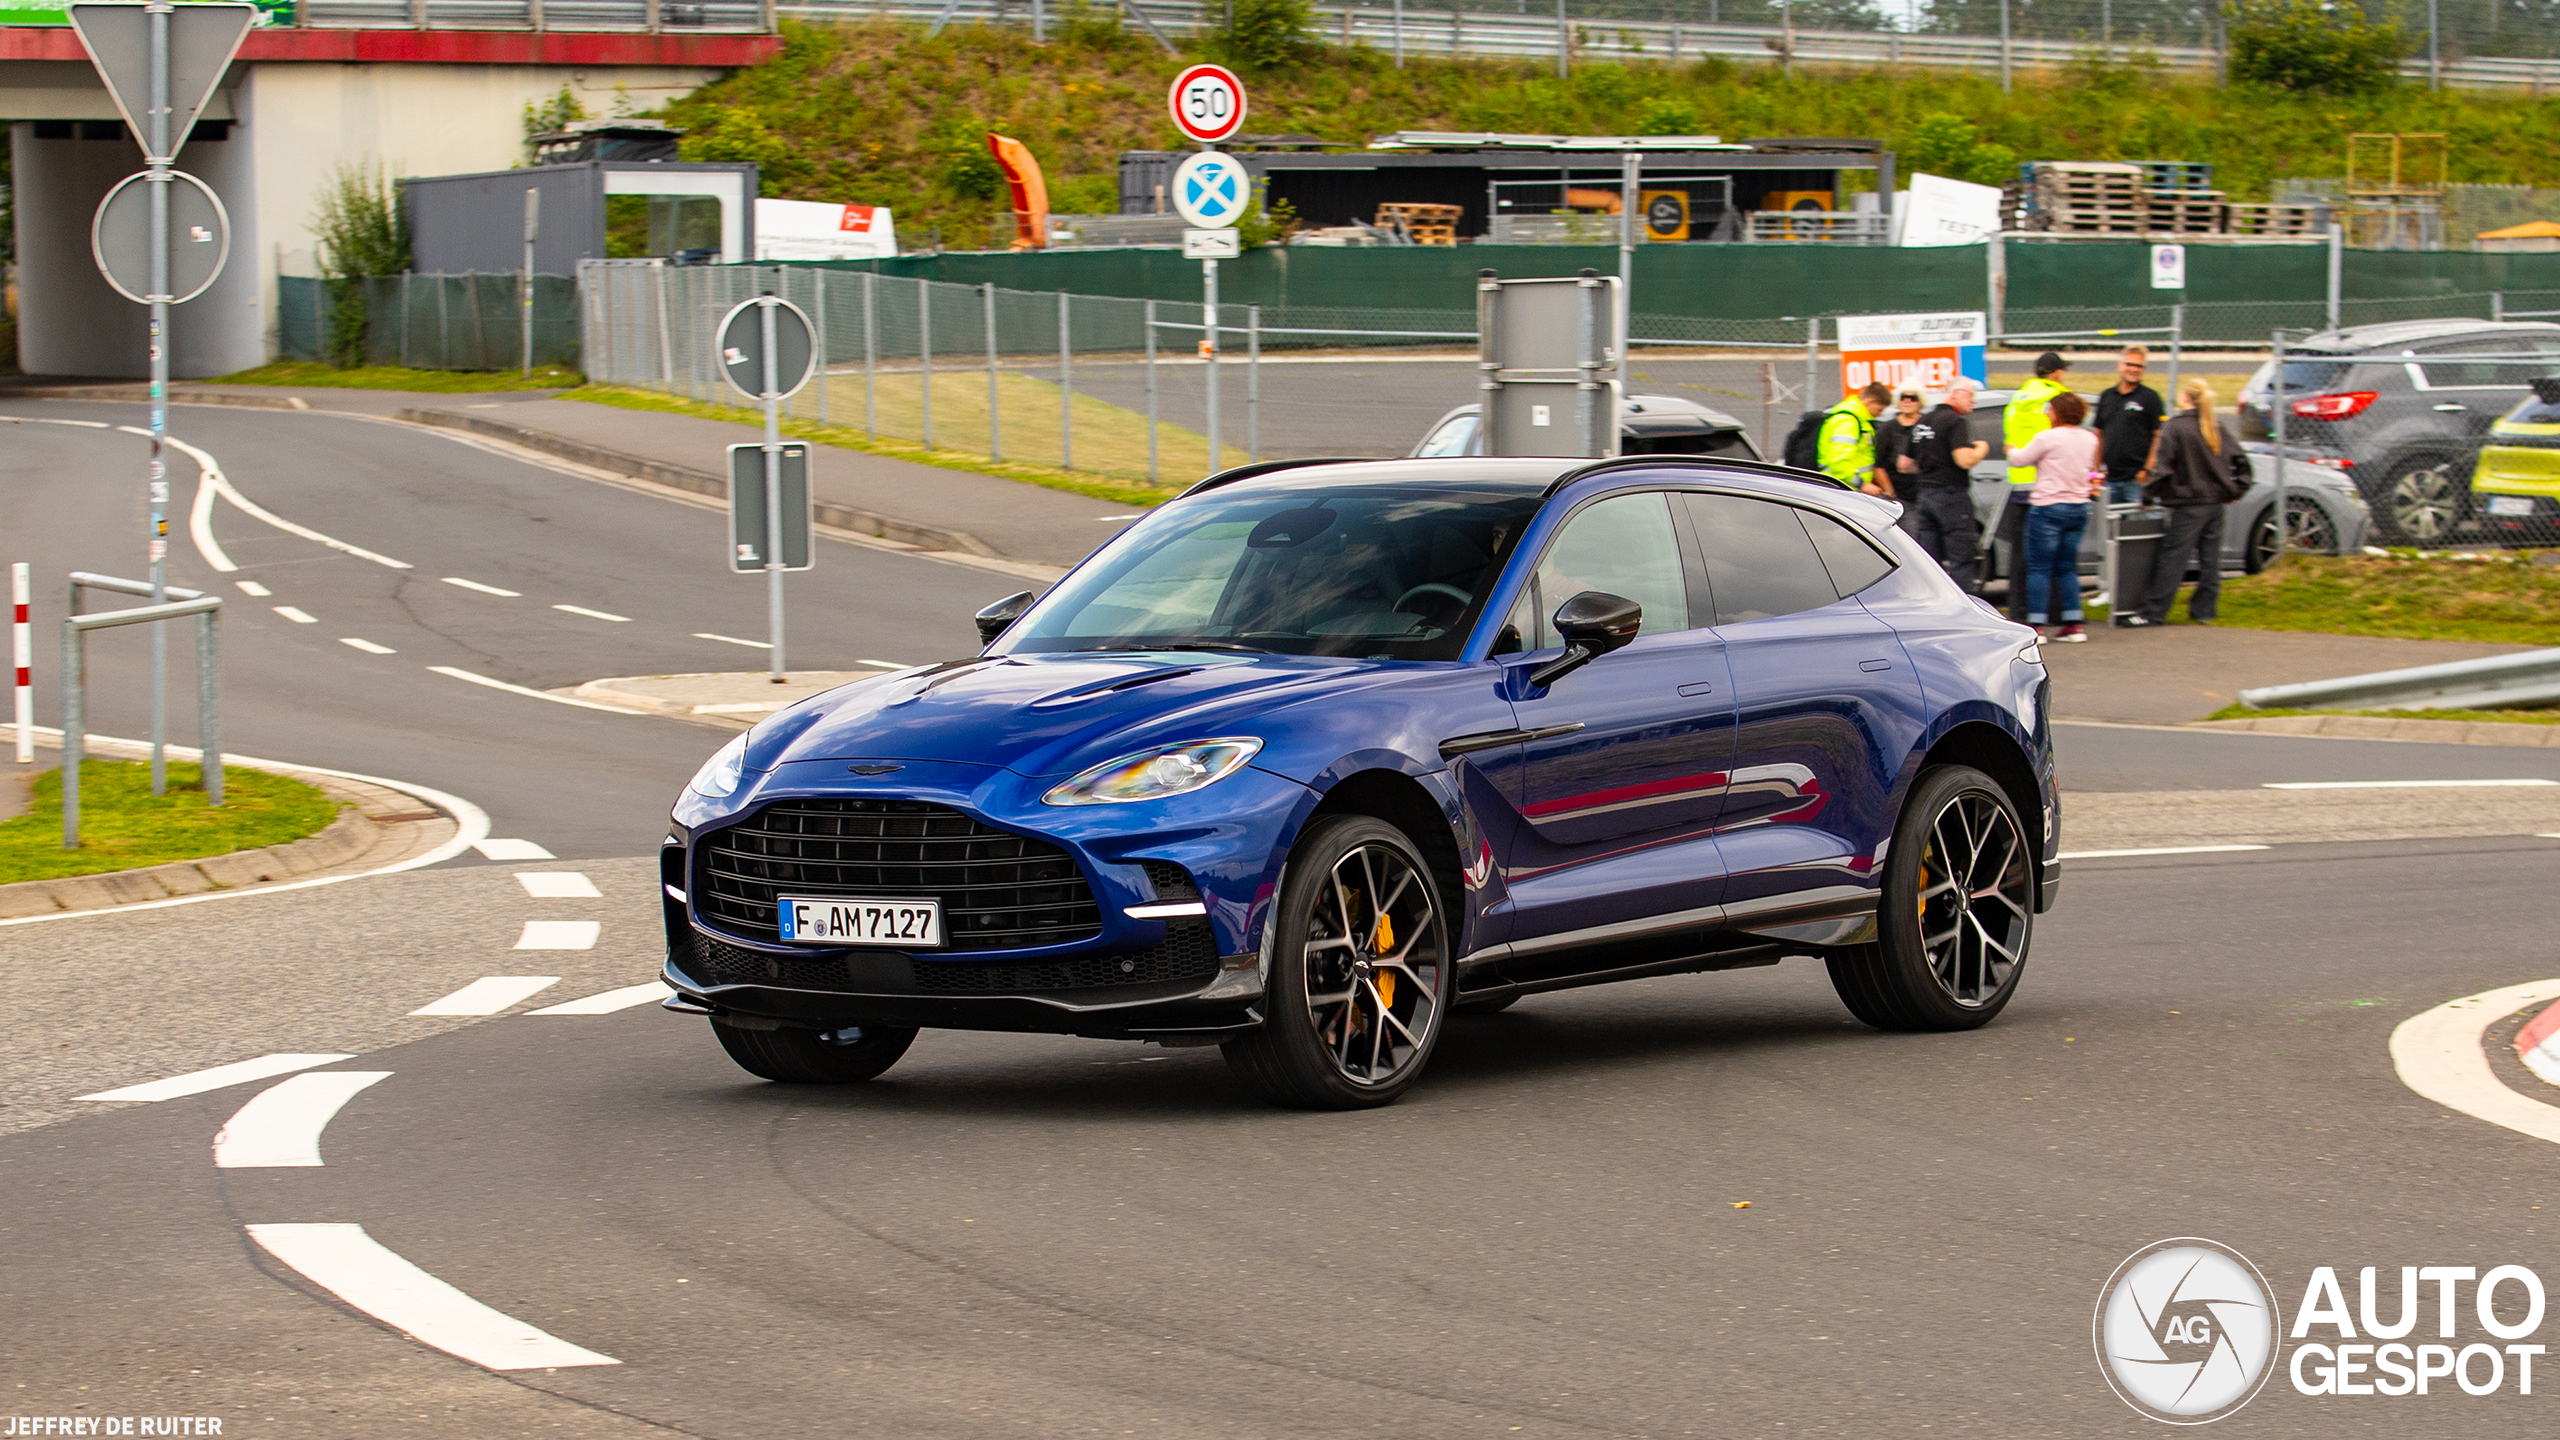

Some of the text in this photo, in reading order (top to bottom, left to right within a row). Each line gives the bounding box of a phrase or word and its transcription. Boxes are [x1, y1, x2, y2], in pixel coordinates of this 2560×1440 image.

[1191, 87, 1227, 118] 50
[1938, 218, 1981, 236] TEST
[1846, 357, 1955, 390] OLDTIMER
[785, 923, 790, 932] D
[796, 905, 810, 934] F
